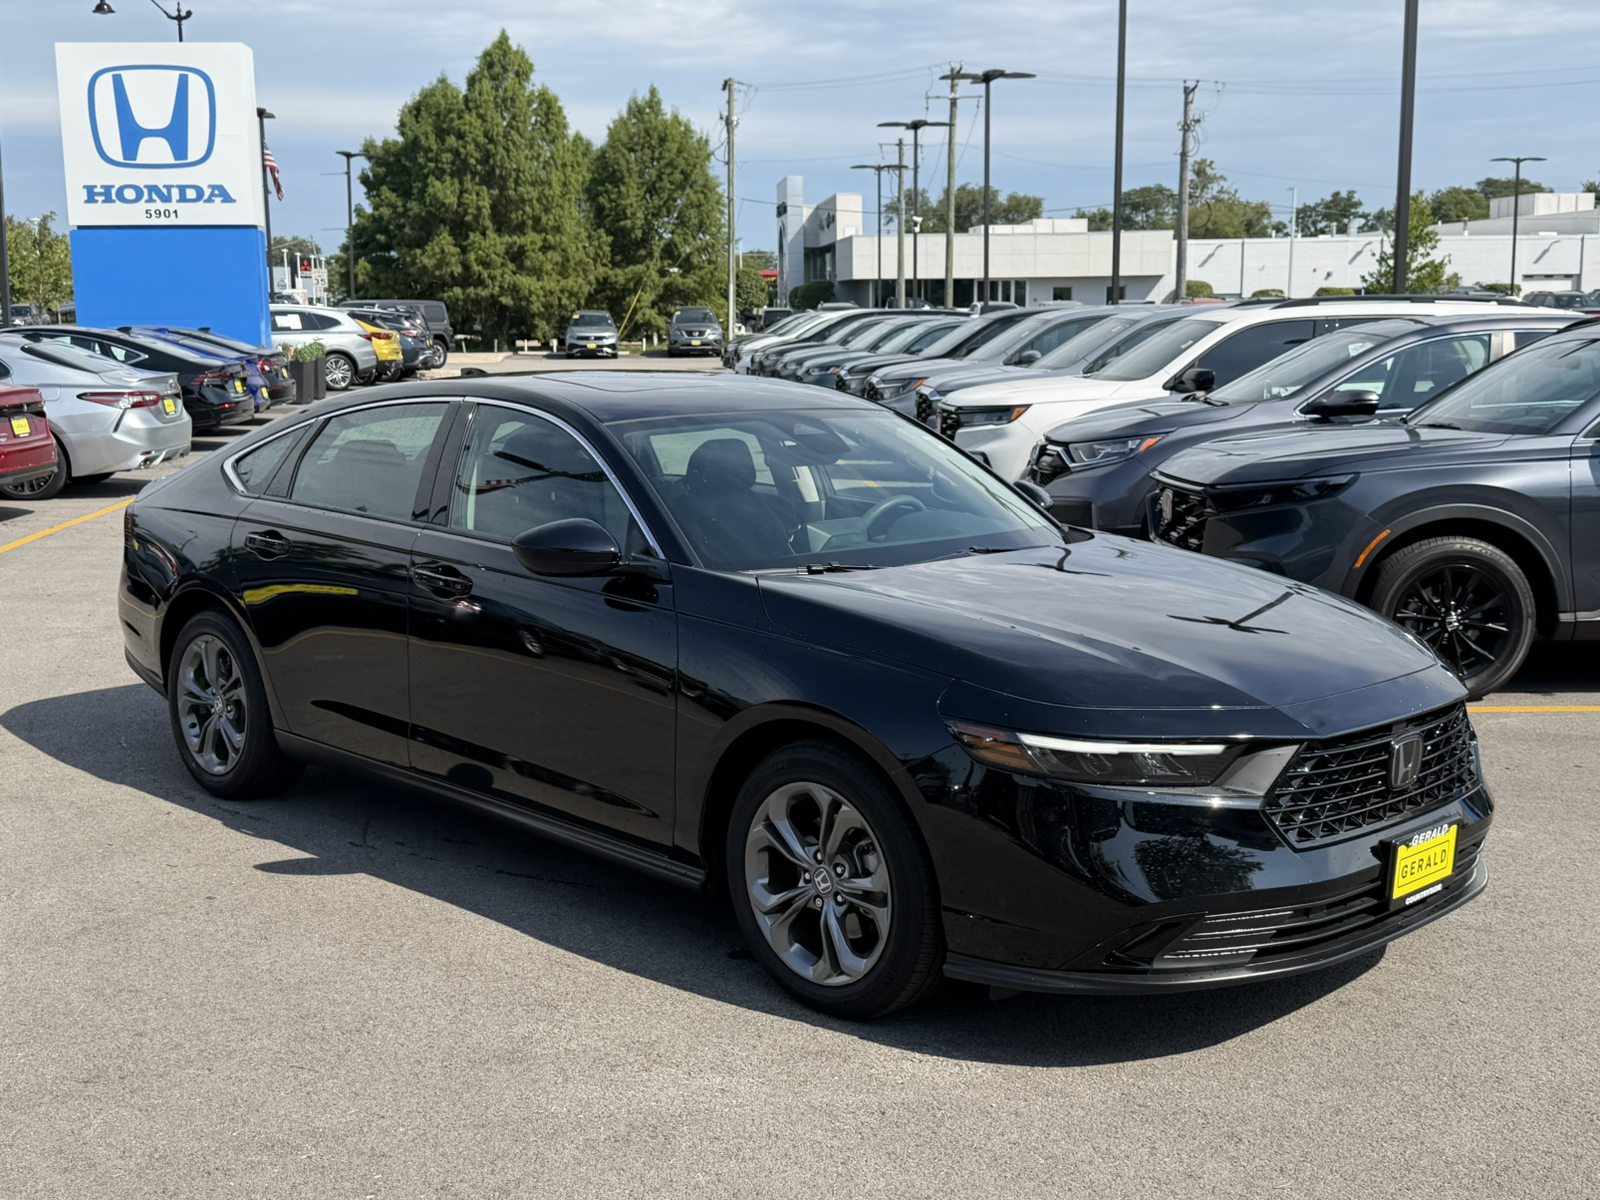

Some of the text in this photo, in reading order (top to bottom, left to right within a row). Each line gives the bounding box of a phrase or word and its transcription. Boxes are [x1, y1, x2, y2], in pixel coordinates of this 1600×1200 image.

[82, 183, 237, 205] HONDA
[145, 208, 179, 219] 5901
[314, 278, 326, 286] 35
[1411, 824, 1449, 846] GERALD
[1401, 849, 1447, 879] GERALD
